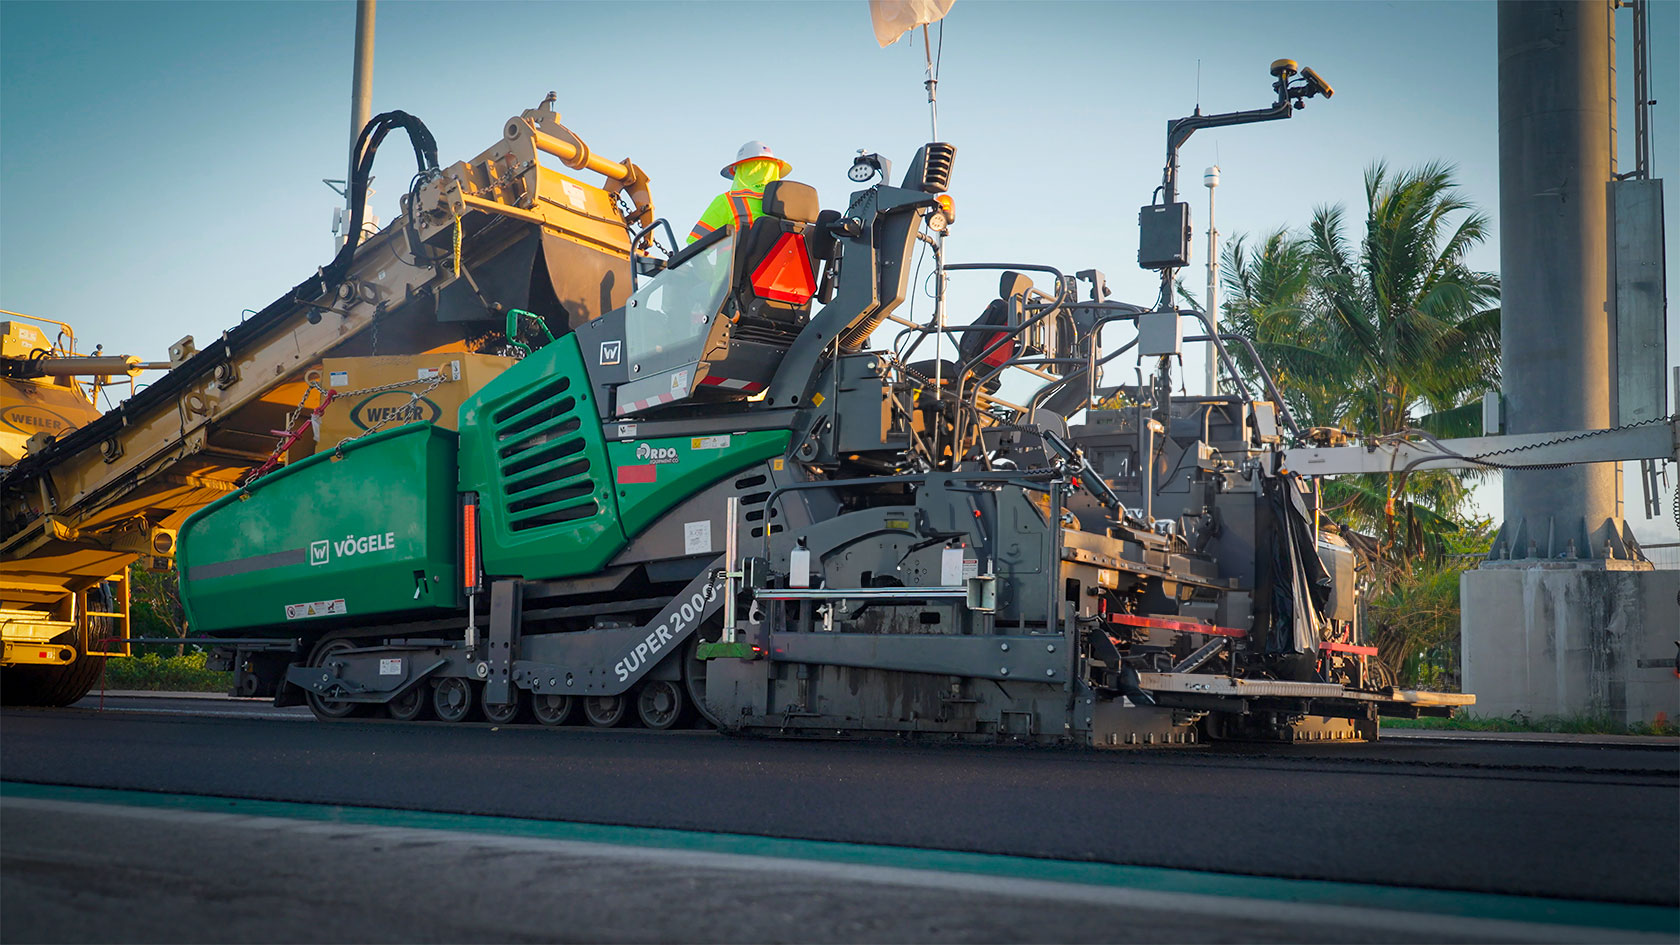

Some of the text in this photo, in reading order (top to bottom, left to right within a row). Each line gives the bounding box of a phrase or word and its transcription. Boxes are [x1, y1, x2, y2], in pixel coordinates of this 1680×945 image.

[11, 413, 62, 429] WEILER
[333, 532, 395, 558] VÖGELE
[614, 583, 726, 682] SUPER 2000-
